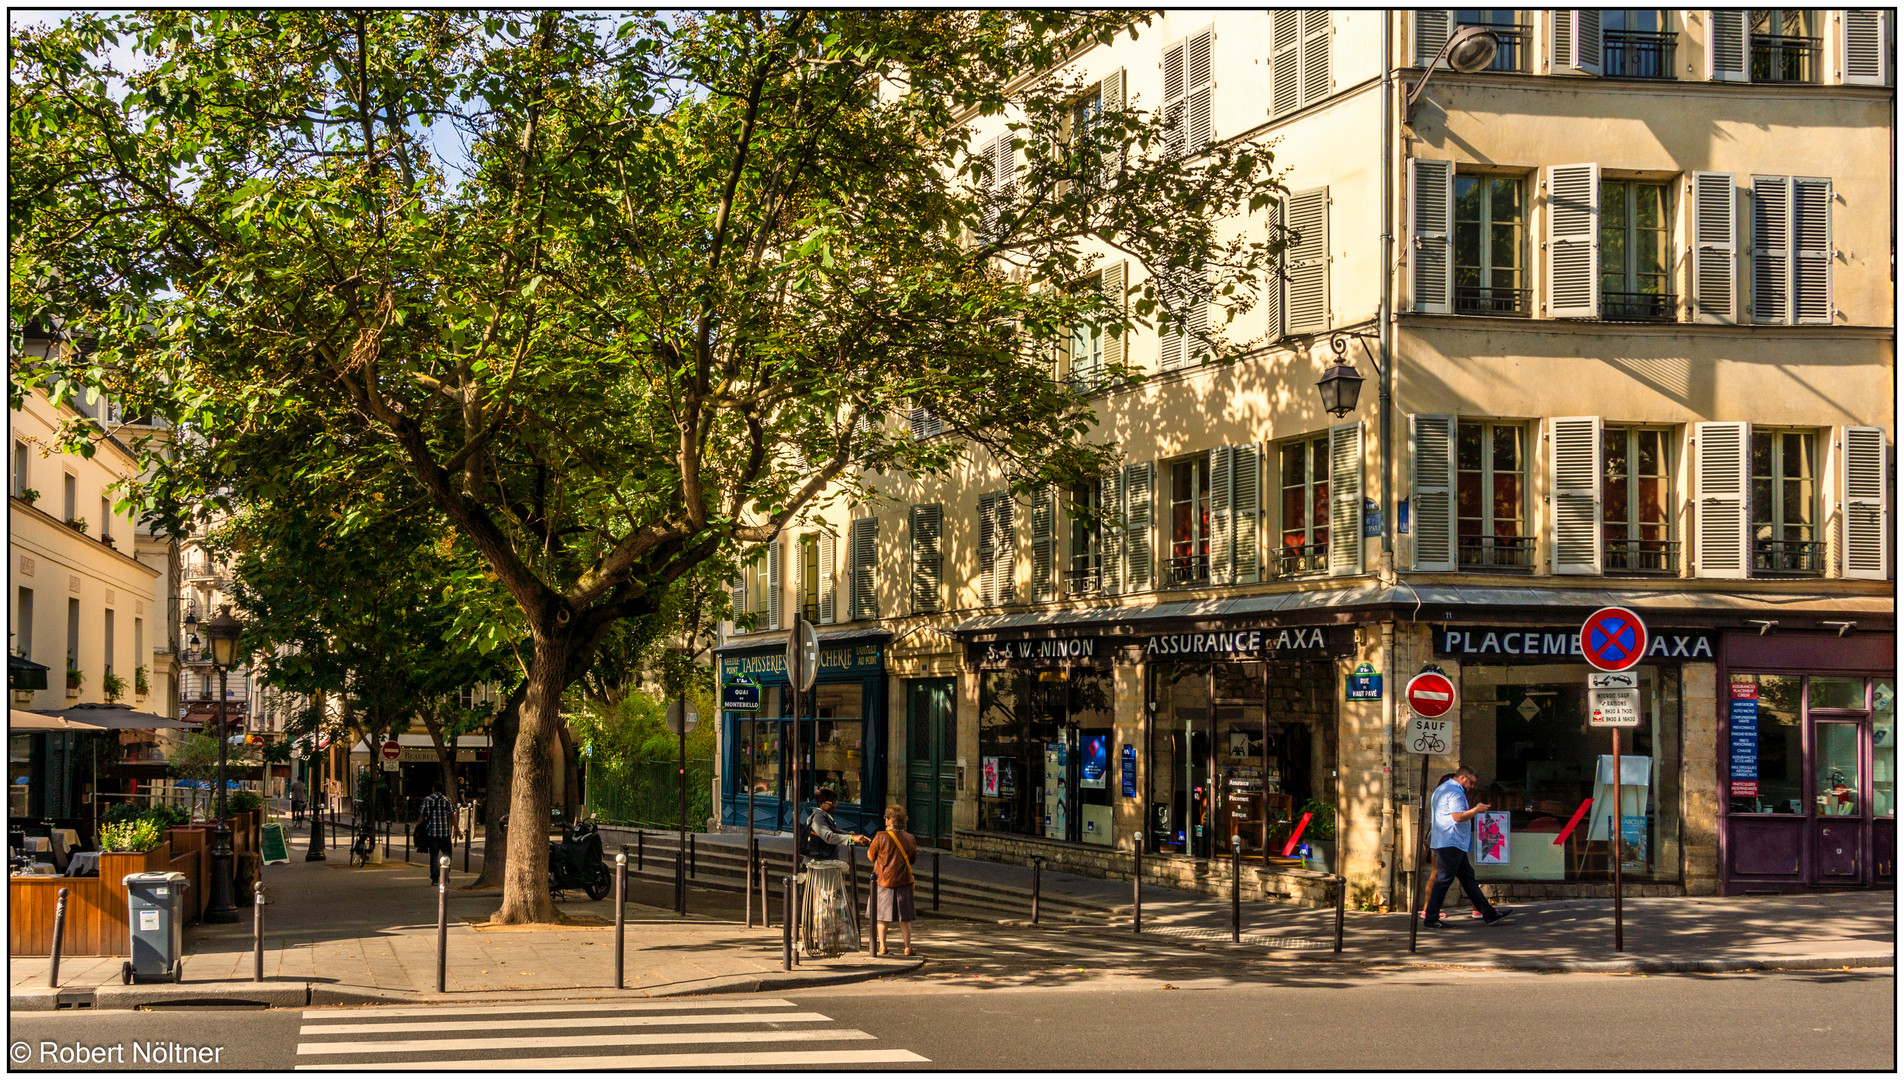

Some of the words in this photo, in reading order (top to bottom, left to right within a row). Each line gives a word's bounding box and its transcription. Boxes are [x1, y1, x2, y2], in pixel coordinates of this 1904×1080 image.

[987, 645, 999, 660] S.
[1004, 642, 1013, 658] &
[1019, 641, 1034, 658] W.
[1041, 638, 1094, 657] NINON
[1147, 631, 1261, 654] ASSURANCE
[1276, 628, 1324, 649] AXA
[1446, 632, 1581, 655] PLACEME
[1649, 636, 1713, 657] AXA
[741, 654, 787, 673] TAPISSERIES
[818, 648, 853, 670] CHERIE
[1365, 689, 1378, 697] PAVÉ
[1416, 721, 1446, 731] SAUF
[405, 752, 439, 760] BEAUREPA
